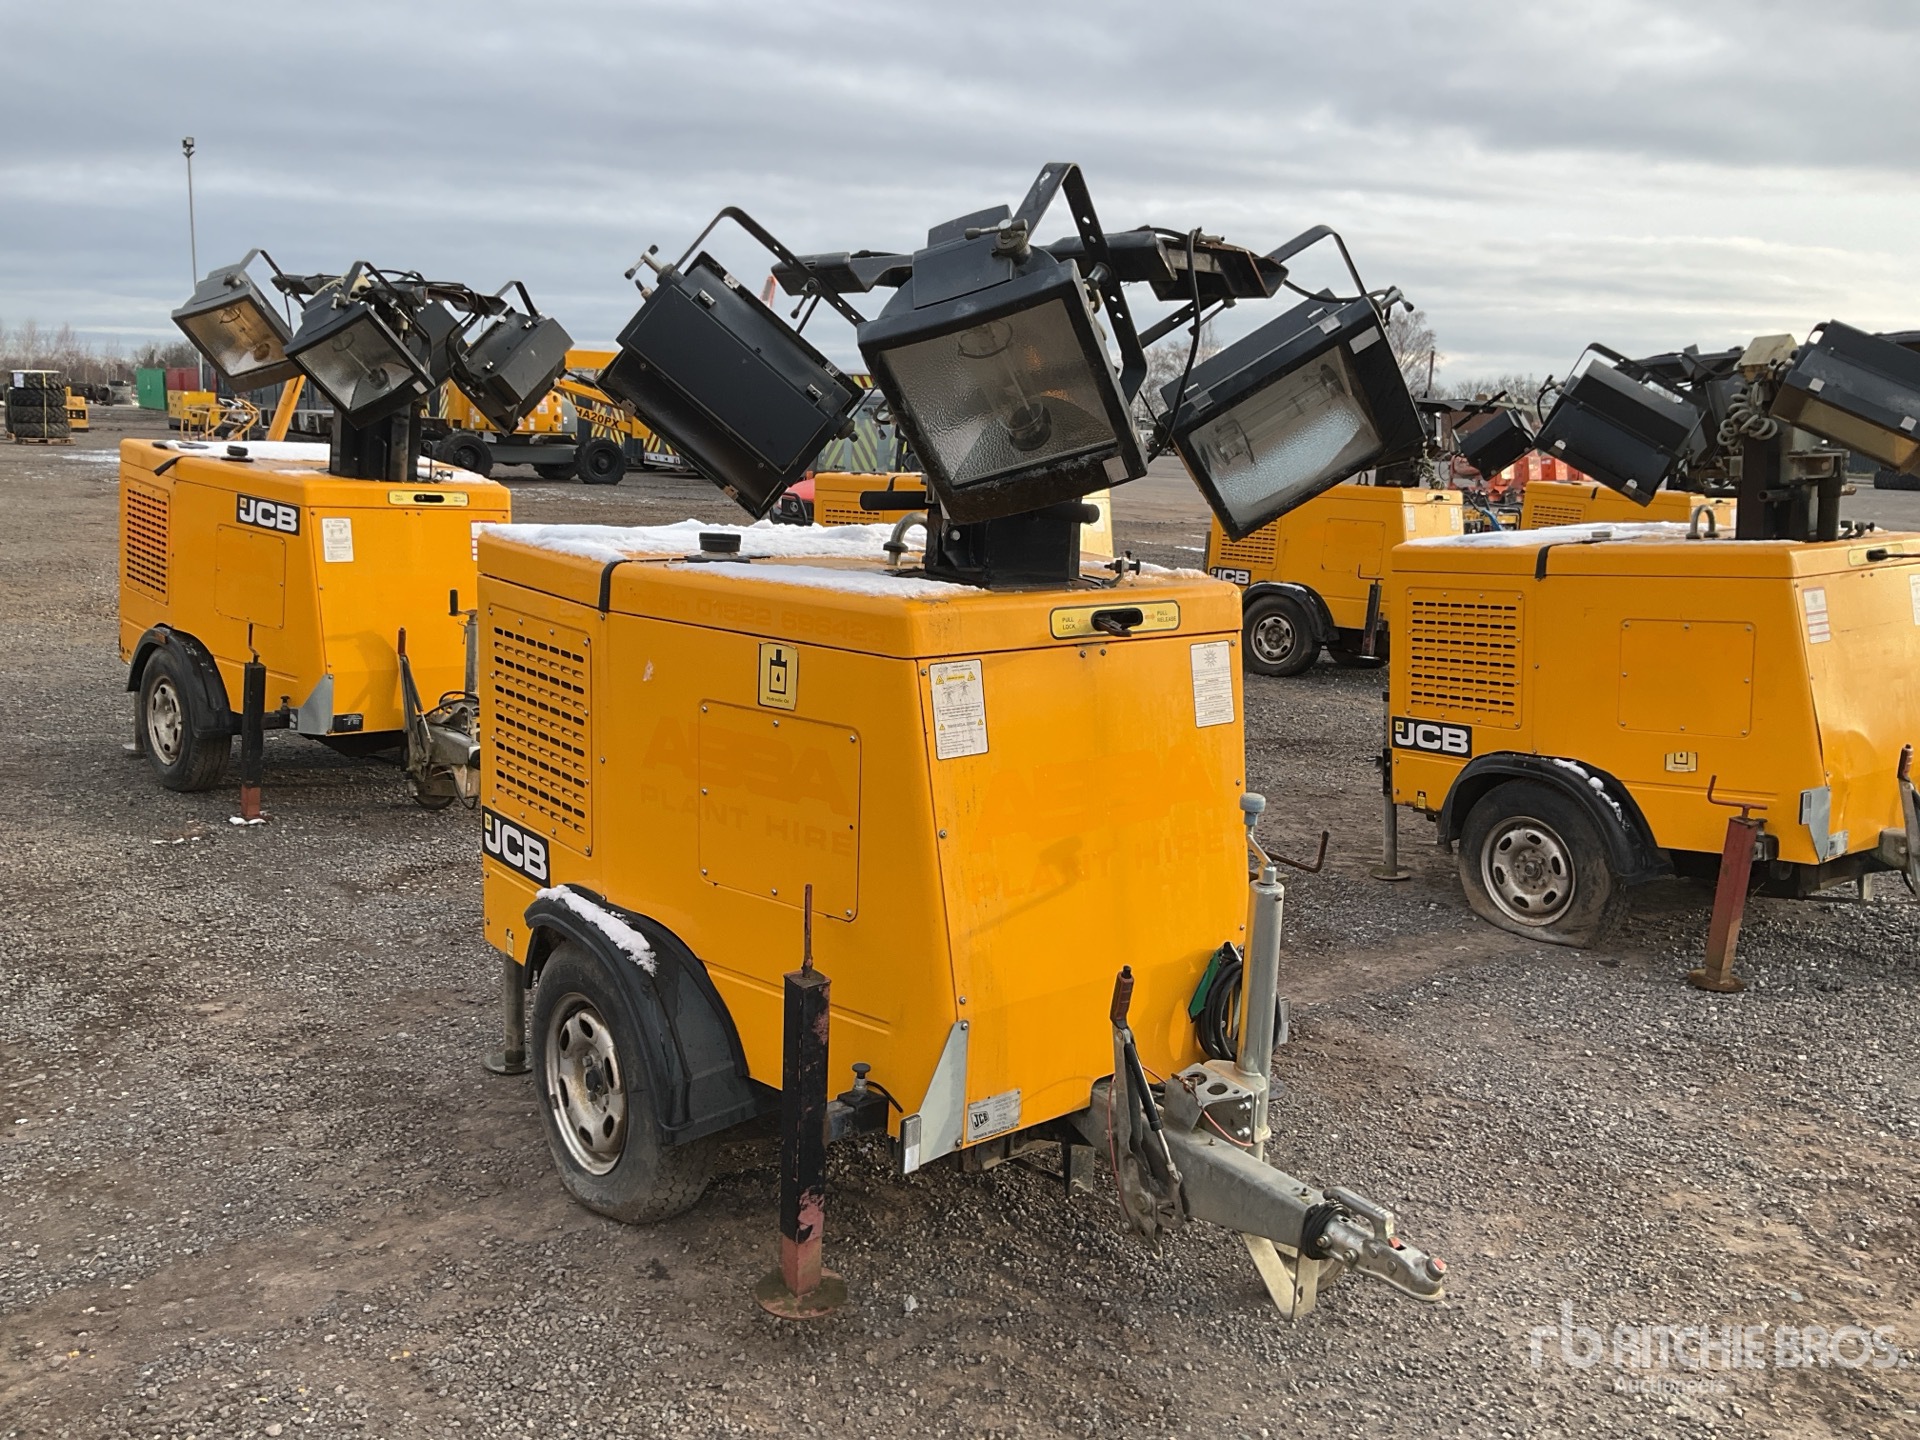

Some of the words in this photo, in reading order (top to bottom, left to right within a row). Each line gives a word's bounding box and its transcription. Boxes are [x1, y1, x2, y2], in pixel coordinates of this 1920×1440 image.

[575, 407, 619, 429] HA20PX
[239, 499, 297, 532] JCB
[1395, 722, 1468, 754] JCB
[641, 783, 749, 831] PLANT
[766, 815, 854, 858] HIRE
[485, 818, 547, 880] JCB
[974, 1113, 988, 1127] JCB
